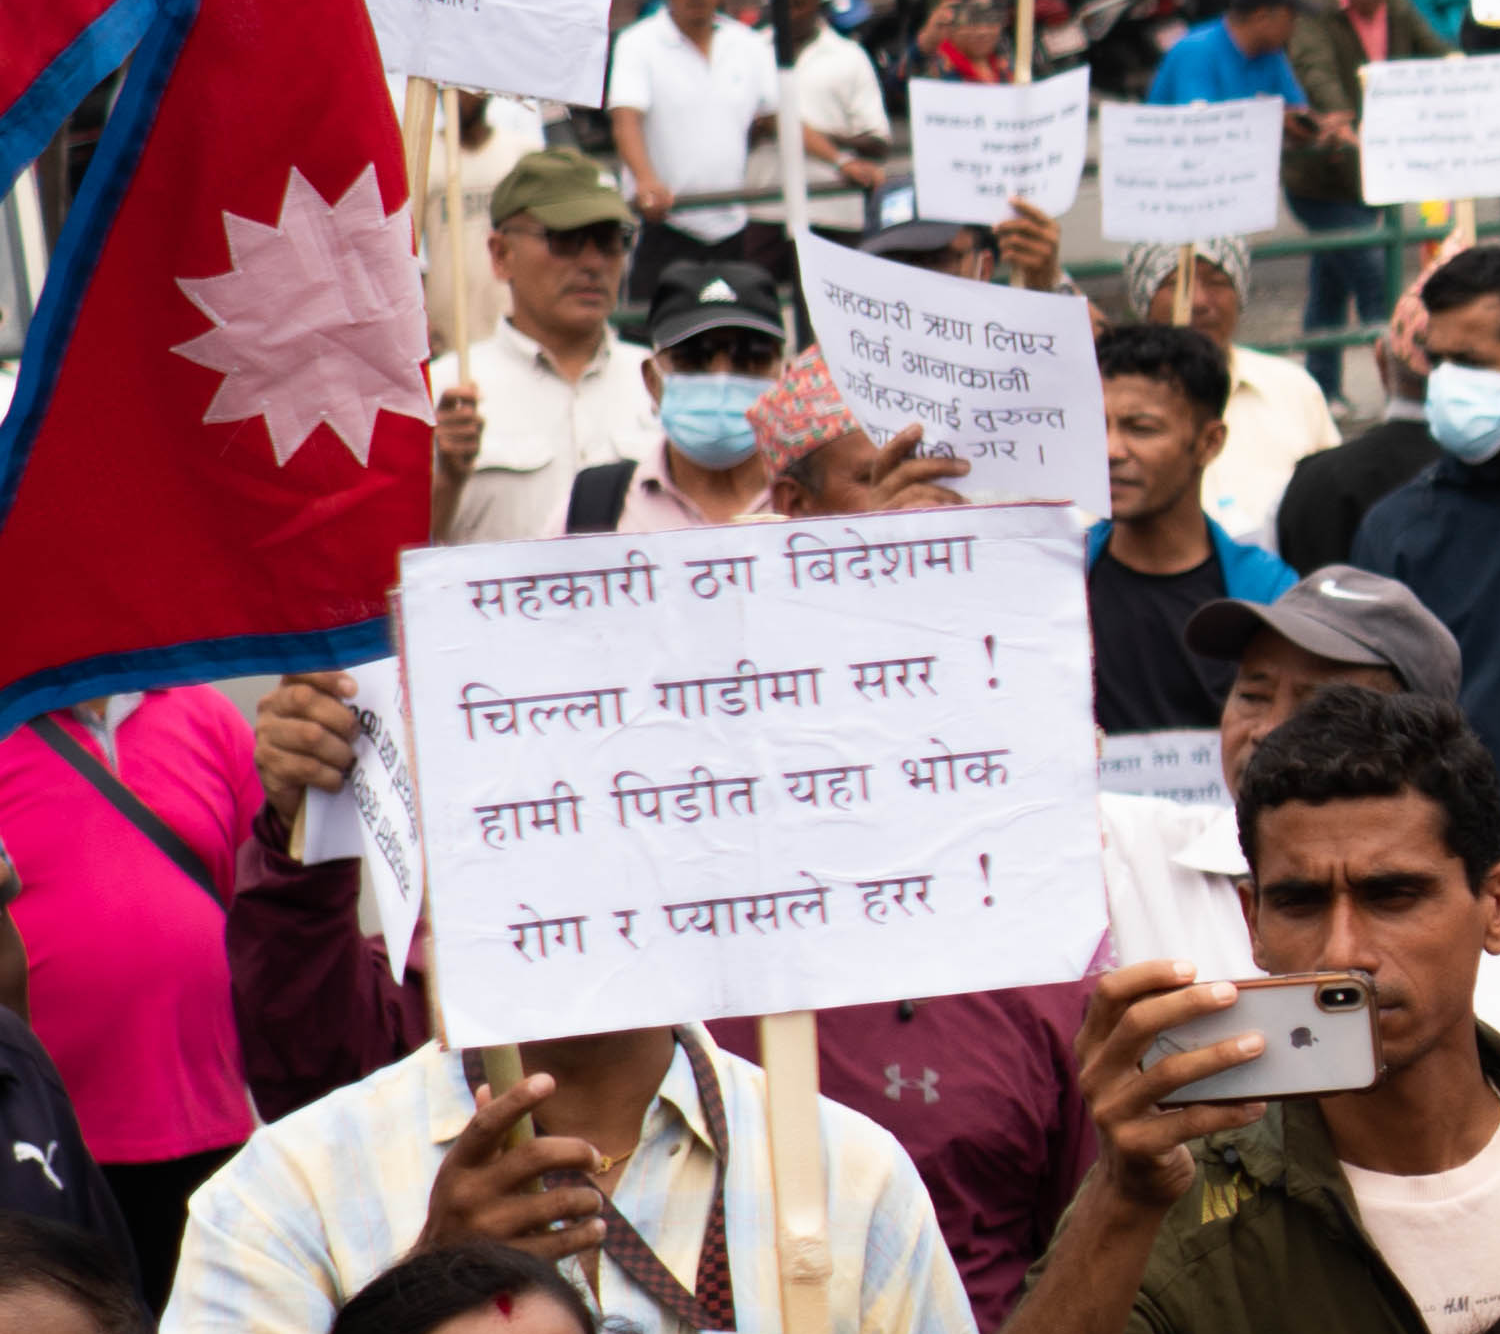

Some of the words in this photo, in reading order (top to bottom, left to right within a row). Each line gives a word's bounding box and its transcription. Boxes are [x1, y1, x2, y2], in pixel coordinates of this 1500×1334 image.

[826, 283, 911, 330] सहकारी
[922, 313, 972, 345] ऋण
[984, 322, 1056, 355] लिएर
[902, 351, 1029, 392] आनाकानी
[974, 440, 1016, 460] गर
[466, 550, 659, 620] सहकारी
[684, 556, 757, 599] ठग
[783, 528, 978, 587] बिदेशमा
[457, 683, 627, 739] चिल्ला
[653, 659, 823, 718] गाडीमा
[849, 656, 936, 697] सरर
[984, 635, 998, 689] !
[473, 781, 583, 843] हामी
[610, 766, 759, 827] पिडीत
[783, 765, 872, 807] यहा
[902, 738, 1009, 793] भोक
[508, 904, 587, 957] रोग
[612, 910, 638, 945] र
[662, 871, 831, 936] प्यासले
[854, 875, 933, 926] हरर
[979, 853, 993, 907] !
